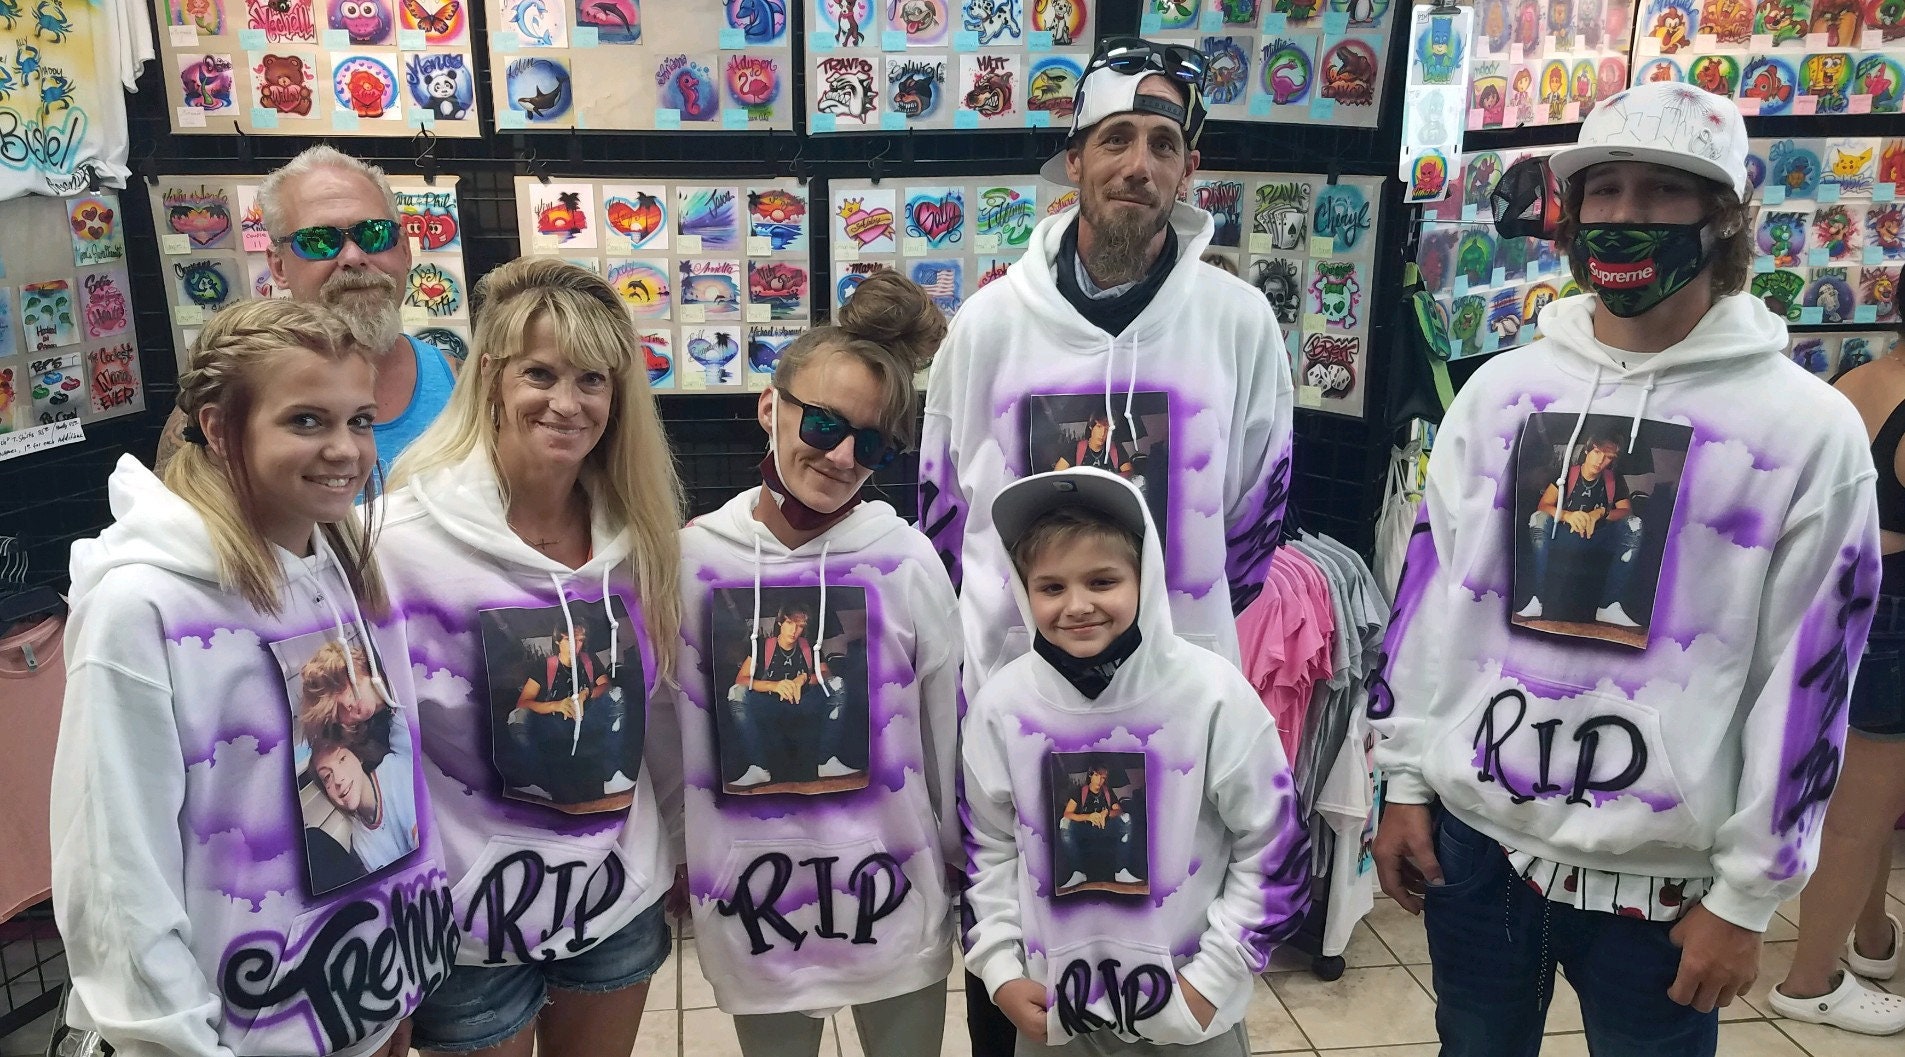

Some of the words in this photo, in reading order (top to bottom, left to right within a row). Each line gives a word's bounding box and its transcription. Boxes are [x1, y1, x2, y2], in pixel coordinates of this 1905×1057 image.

[976, 55, 1010, 72] MATT
[1588, 261, 1654, 285] Supreme
[99, 386, 135, 411] EVER
[1473, 689, 1647, 808] RIP
[463, 850, 626, 965] RIP
[719, 851, 911, 956] RIP
[1055, 957, 1173, 1042] RIP
